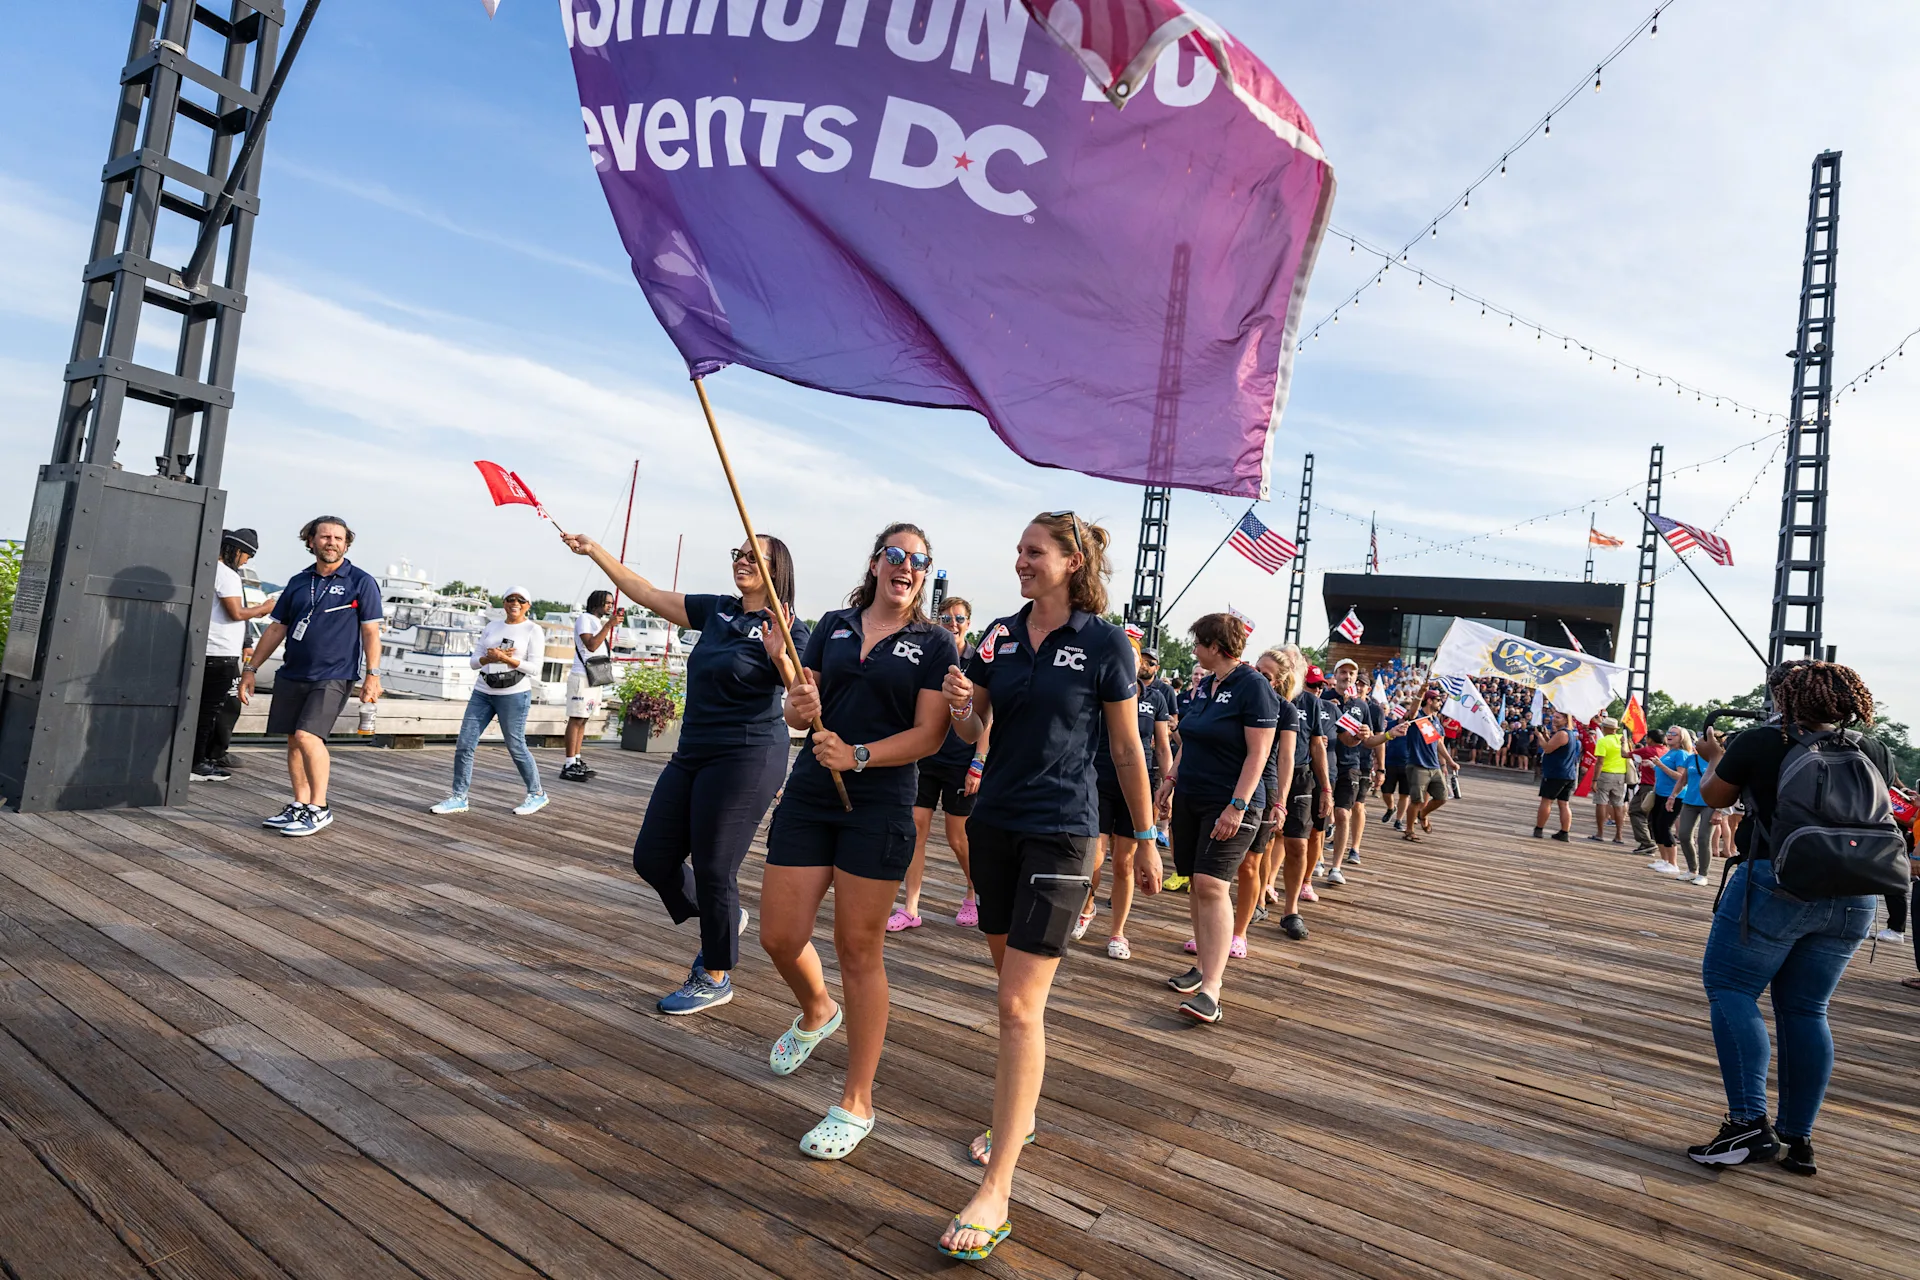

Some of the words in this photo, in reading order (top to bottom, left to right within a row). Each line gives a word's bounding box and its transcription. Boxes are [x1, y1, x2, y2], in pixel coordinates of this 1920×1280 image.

[869, 95, 1048, 217] DC
[892, 641, 924, 664] DC
[1053, 649, 1088, 670] DC
